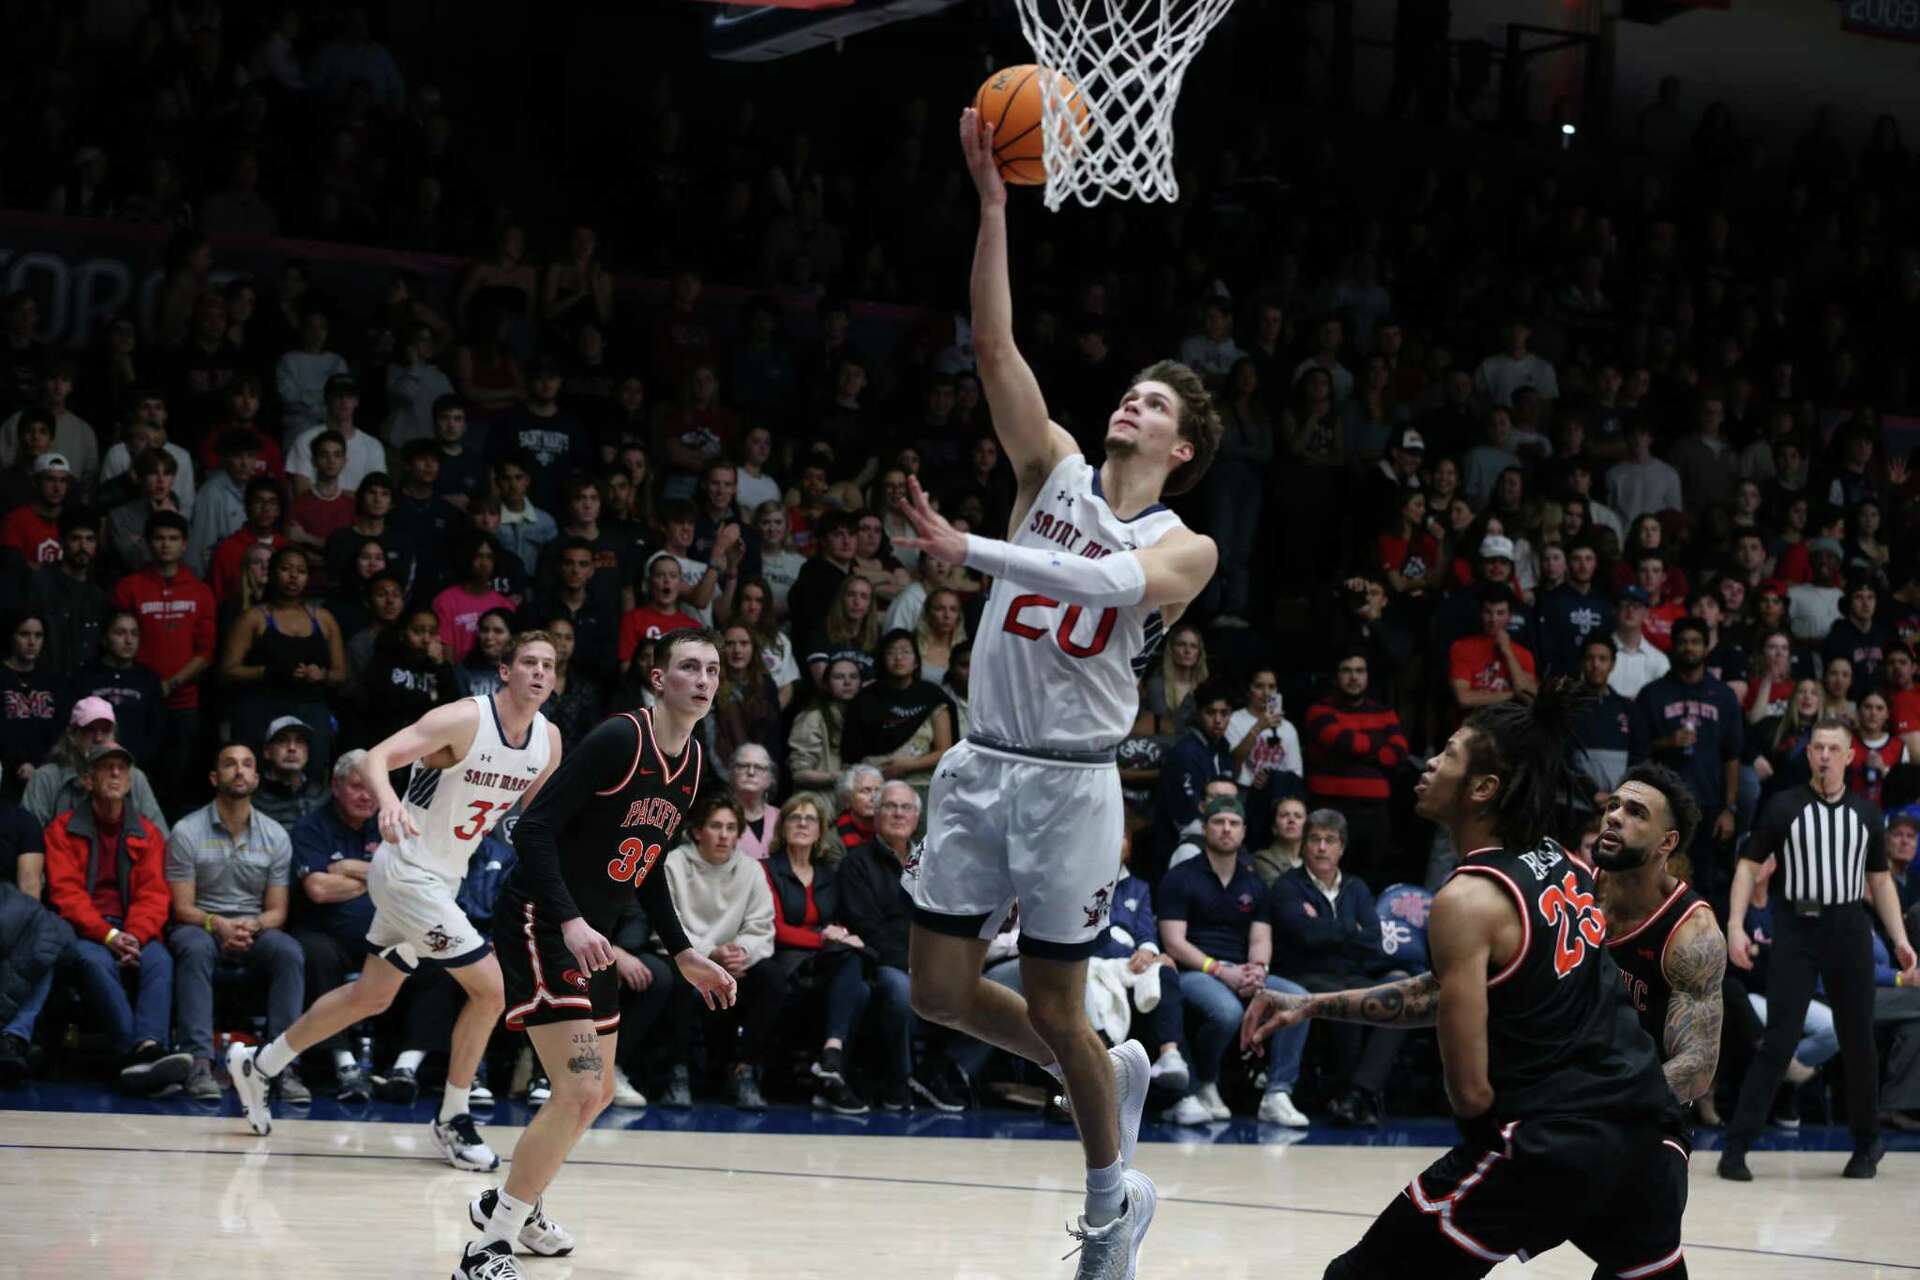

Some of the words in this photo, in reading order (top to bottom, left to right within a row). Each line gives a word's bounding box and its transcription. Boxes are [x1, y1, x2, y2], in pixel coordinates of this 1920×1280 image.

[1030, 510, 1082, 550] SAINT
[1002, 594, 1118, 658] 20
[464, 768, 500, 788] SAINT
[607, 836, 662, 888] 33
[1538, 870, 1607, 980] 25
